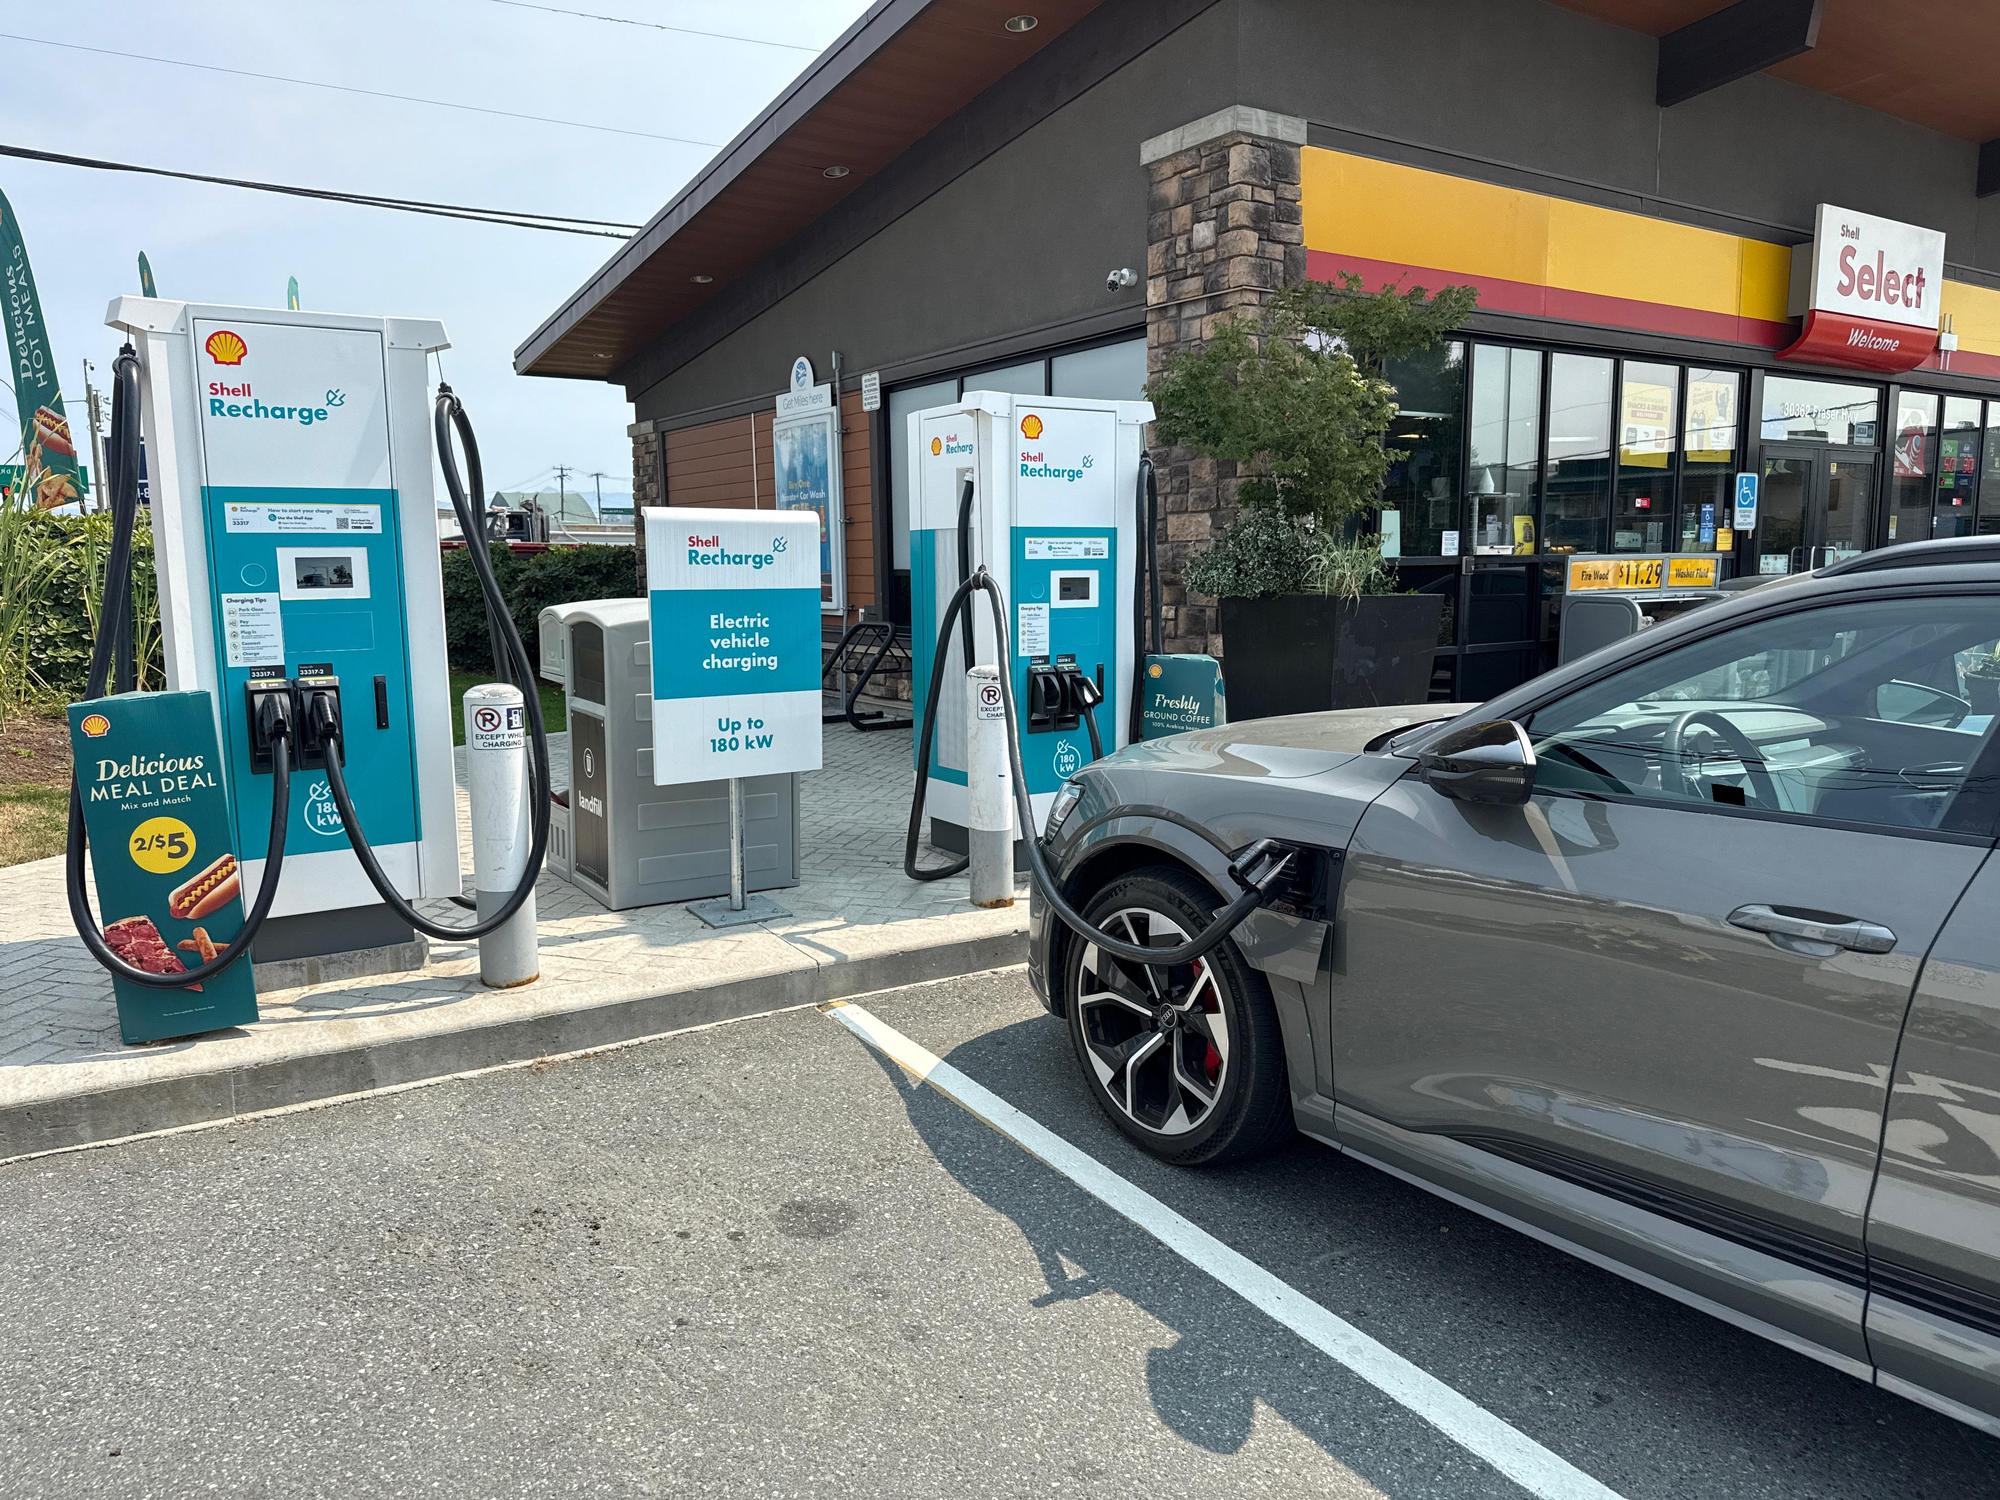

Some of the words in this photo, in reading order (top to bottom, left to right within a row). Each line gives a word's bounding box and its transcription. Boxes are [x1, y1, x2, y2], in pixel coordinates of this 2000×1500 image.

[1840, 224, 1860, 240] Shell
[13, 244, 36, 325] MEALS
[1837, 245, 1925, 308] Select
[6, 265, 33, 383] Delicious
[1847, 328, 1900, 351] Welcome
[29, 338, 48, 388] HOT
[209, 382, 251, 397] Shell
[209, 398, 328, 425] Recharge
[1784, 402, 1810, 417] 30362
[1813, 405, 1840, 420] Fraser
[1841, 408, 1857, 425] Hwy
[946, 434, 958, 443] Shell
[946, 443, 973, 455] Recharg
[1021, 452, 1044, 462] Shell
[1020, 463, 1083, 482] Recharge
[800, 491, 809, 500] Car
[809, 489, 826, 499] Wash
[688, 535, 719, 547] Shell
[688, 549, 774, 569] Recharge
[1581, 571, 1592, 581] Fire
[1593, 570, 1610, 581] Wood
[1619, 563, 1662, 585] $11.29
[1675, 568, 1695, 579] Washer
[1695, 568, 1709, 579] Fluid
[710, 613, 770, 629] Electric
[711, 632, 770, 649] vehicle
[702, 653, 778, 671] charging
[1155, 693, 1200, 715] Freshly
[718, 718, 742, 735] Up
[747, 717, 764, 730] to
[1143, 710, 1178, 721] GROUND
[1180, 714, 1210, 725] COFFEE
[482, 740, 522, 748] CHARGING
[710, 737, 740, 753] 180
[745, 735, 774, 750] kW
[96, 753, 204, 782] Delicious
[1060, 754, 1075, 763] 180
[1060, 763, 1075, 773] kW
[90, 780, 152, 802] MEAL
[161, 772, 217, 794] DEAL
[121, 800, 139, 811] Mix
[141, 798, 160, 808] and
[162, 795, 192, 805] Match
[578, 790, 603, 818] landfill
[317, 813, 343, 827] kW
[134, 832, 189, 860] 2/$5
